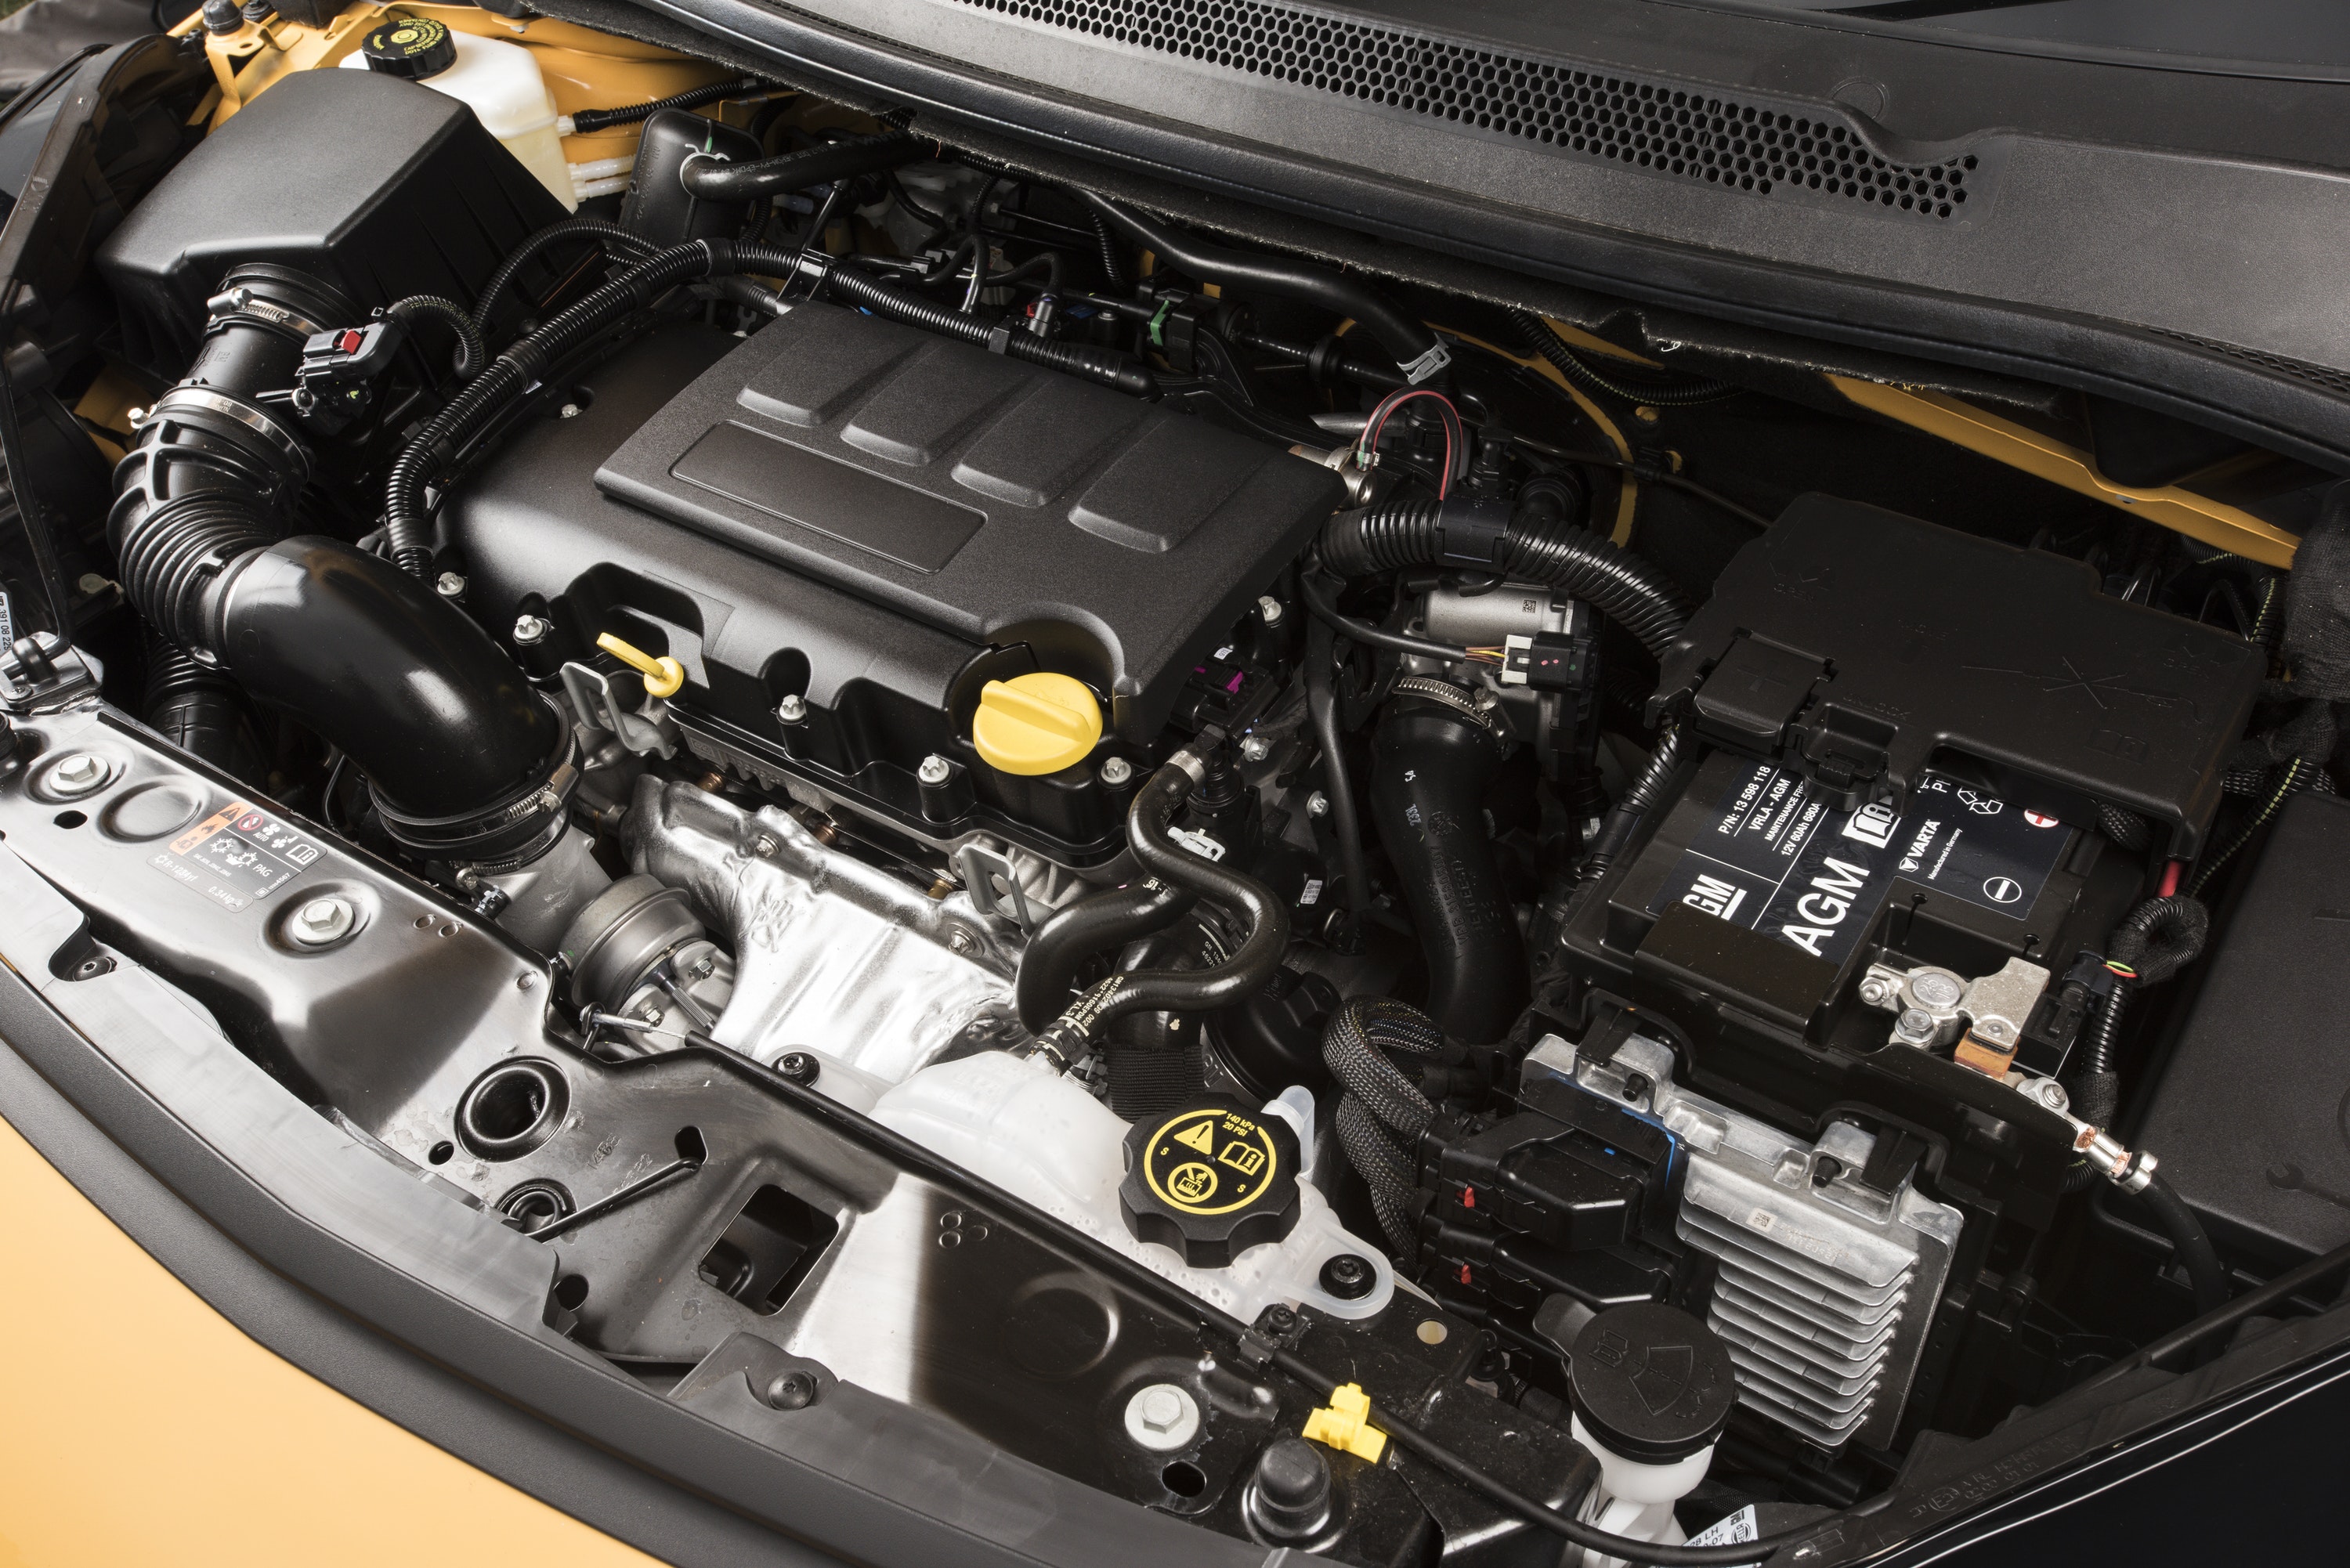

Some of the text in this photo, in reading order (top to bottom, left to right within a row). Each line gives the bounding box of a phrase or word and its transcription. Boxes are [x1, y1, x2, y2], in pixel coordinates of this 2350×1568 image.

[1, 626, 9, 634] 08
[1718, 766, 1770, 834] P/N: 13 598 118
[1748, 807, 1773, 830] VRLA
[1770, 779, 1791, 801] AGM
[1764, 797, 1799, 841] MAINTENANCE
[253, 833, 269, 842] AUTO
[1781, 803, 1822, 856] 12V 60Ah 680A
[1907, 820, 1941, 857] VARTA
[1928, 850, 1949, 880] Manufactured
[1946, 828, 1963, 847] Germany
[252, 864, 273, 877] PAG
[1683, 874, 1736, 916] GM
[1781, 856, 1870, 957] AGM
[1083, 1013, 1095, 1027] 002
[1222, 1122, 1249, 1137] 20 PSI
[1226, 1113, 1255, 1131] 140 kPa
[1160, 1147, 1170, 1156] S
[1237, 1184, 1246, 1193] S
[1705, 1526, 1719, 1541] LH
